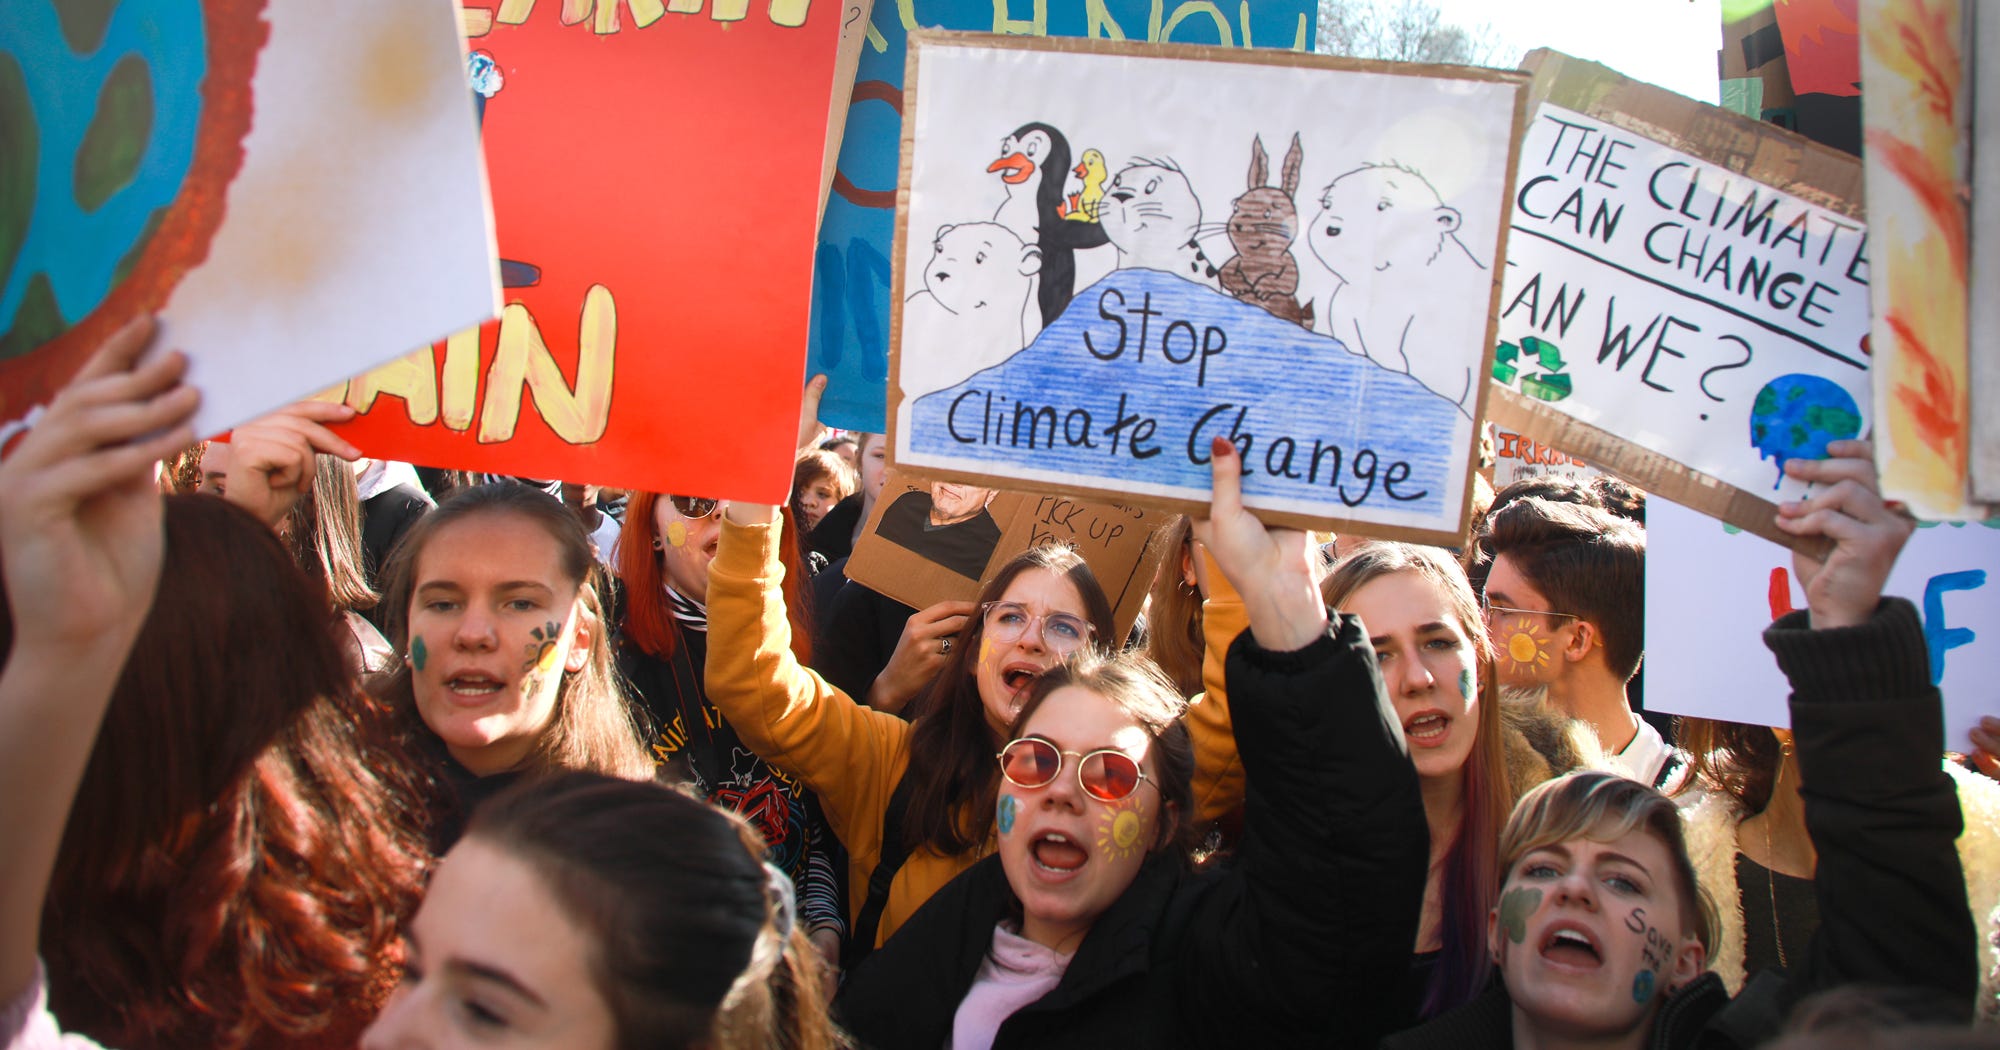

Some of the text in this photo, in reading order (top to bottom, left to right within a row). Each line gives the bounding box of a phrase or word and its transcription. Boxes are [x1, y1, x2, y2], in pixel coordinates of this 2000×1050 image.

[1516, 175, 1841, 328] CAN CHANGE
[1543, 113, 1869, 286] THE CLIMATE
[1083, 287, 1228, 388] Stop
[1501, 261, 1586, 340] AN
[947, 389, 1429, 508] Climate Change
[1089, 517, 1124, 548] UP
